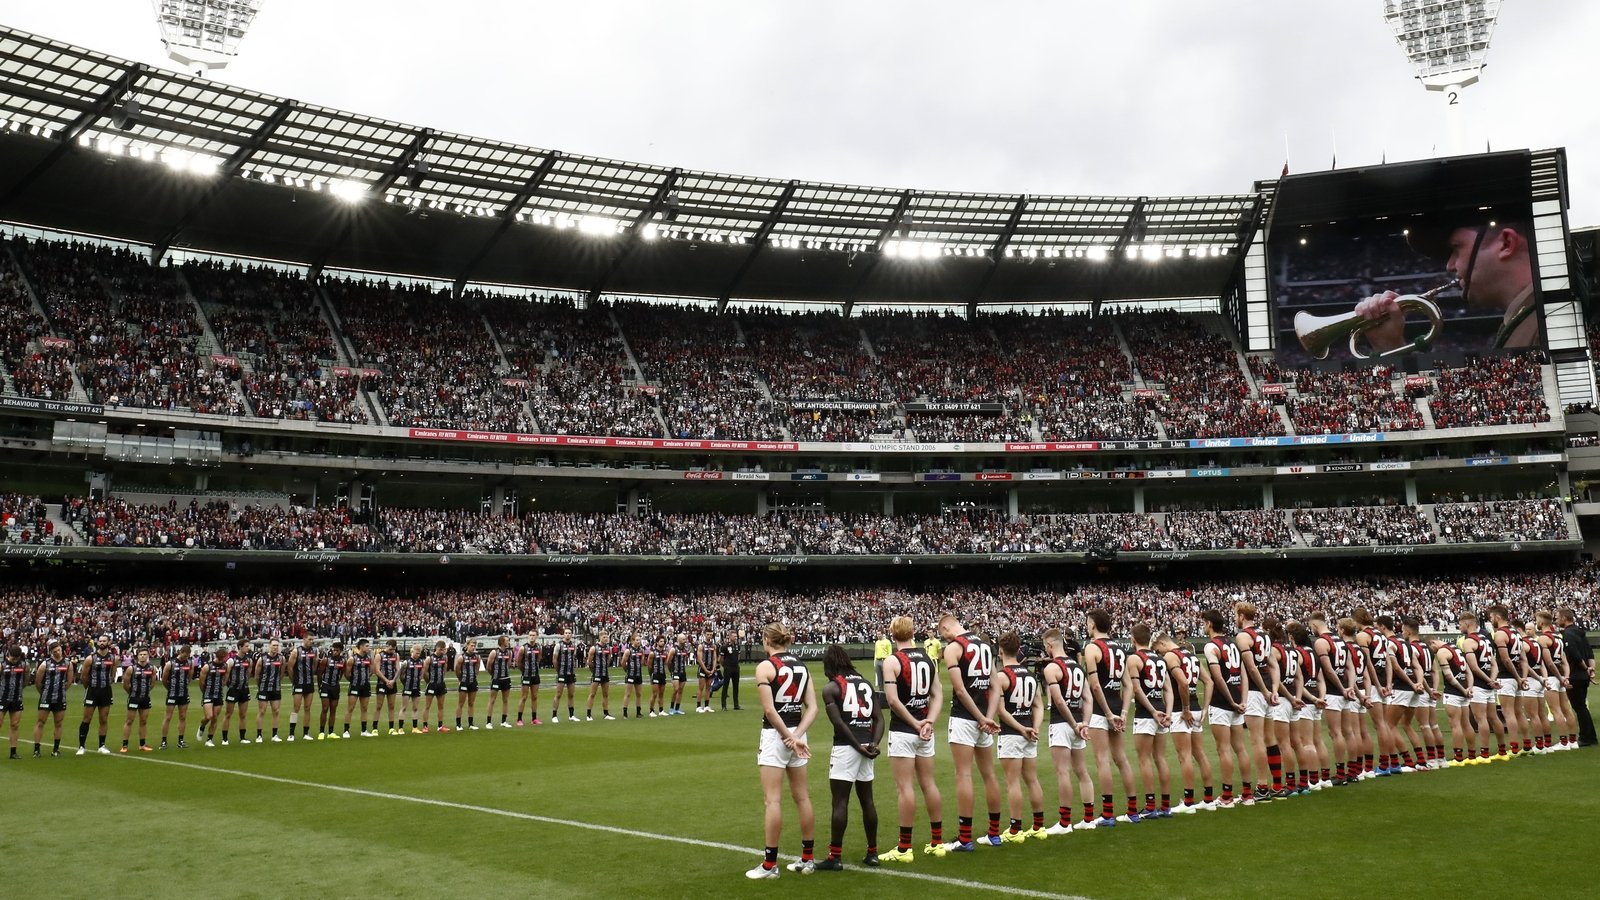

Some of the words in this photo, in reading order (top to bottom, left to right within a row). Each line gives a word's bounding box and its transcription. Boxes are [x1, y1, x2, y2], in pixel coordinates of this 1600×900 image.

[1448, 92, 1458, 105] 2
[3, 399, 40, 408] BEHAVIOUR
[45, 402, 60, 410] TEXT
[1204, 439, 1231, 447] United
[1252, 438, 1278, 446] United
[1300, 436, 1327, 444] United
[1350, 434, 1376, 442] United
[5, 546, 22, 554] Lest
[33, 546, 60, 557] forget
[295, 552, 308, 560] Lest
[318, 552, 340, 562] forget
[798, 646, 826, 658] forget
[967, 643, 992, 677] 20
[1109, 648, 1126, 678] 13
[1222, 642, 1241, 670] 30
[1284, 650, 1298, 676] 16
[1333, 641, 1346, 667] 15
[1356, 650, 1364, 674] 3
[1402, 643, 1411, 667] 4
[1422, 648, 1432, 672] 11
[1456, 648, 1467, 672] 5
[1479, 640, 1494, 662] 25
[1144, 660, 1167, 688] 33
[1182, 656, 1200, 684] 35
[1310, 652, 1316, 678] 1
[775, 666, 808, 703] 27
[910, 662, 930, 696] 10
[1065, 667, 1085, 699] 19
[842, 682, 874, 718] 43
[1010, 676, 1036, 709] 40
